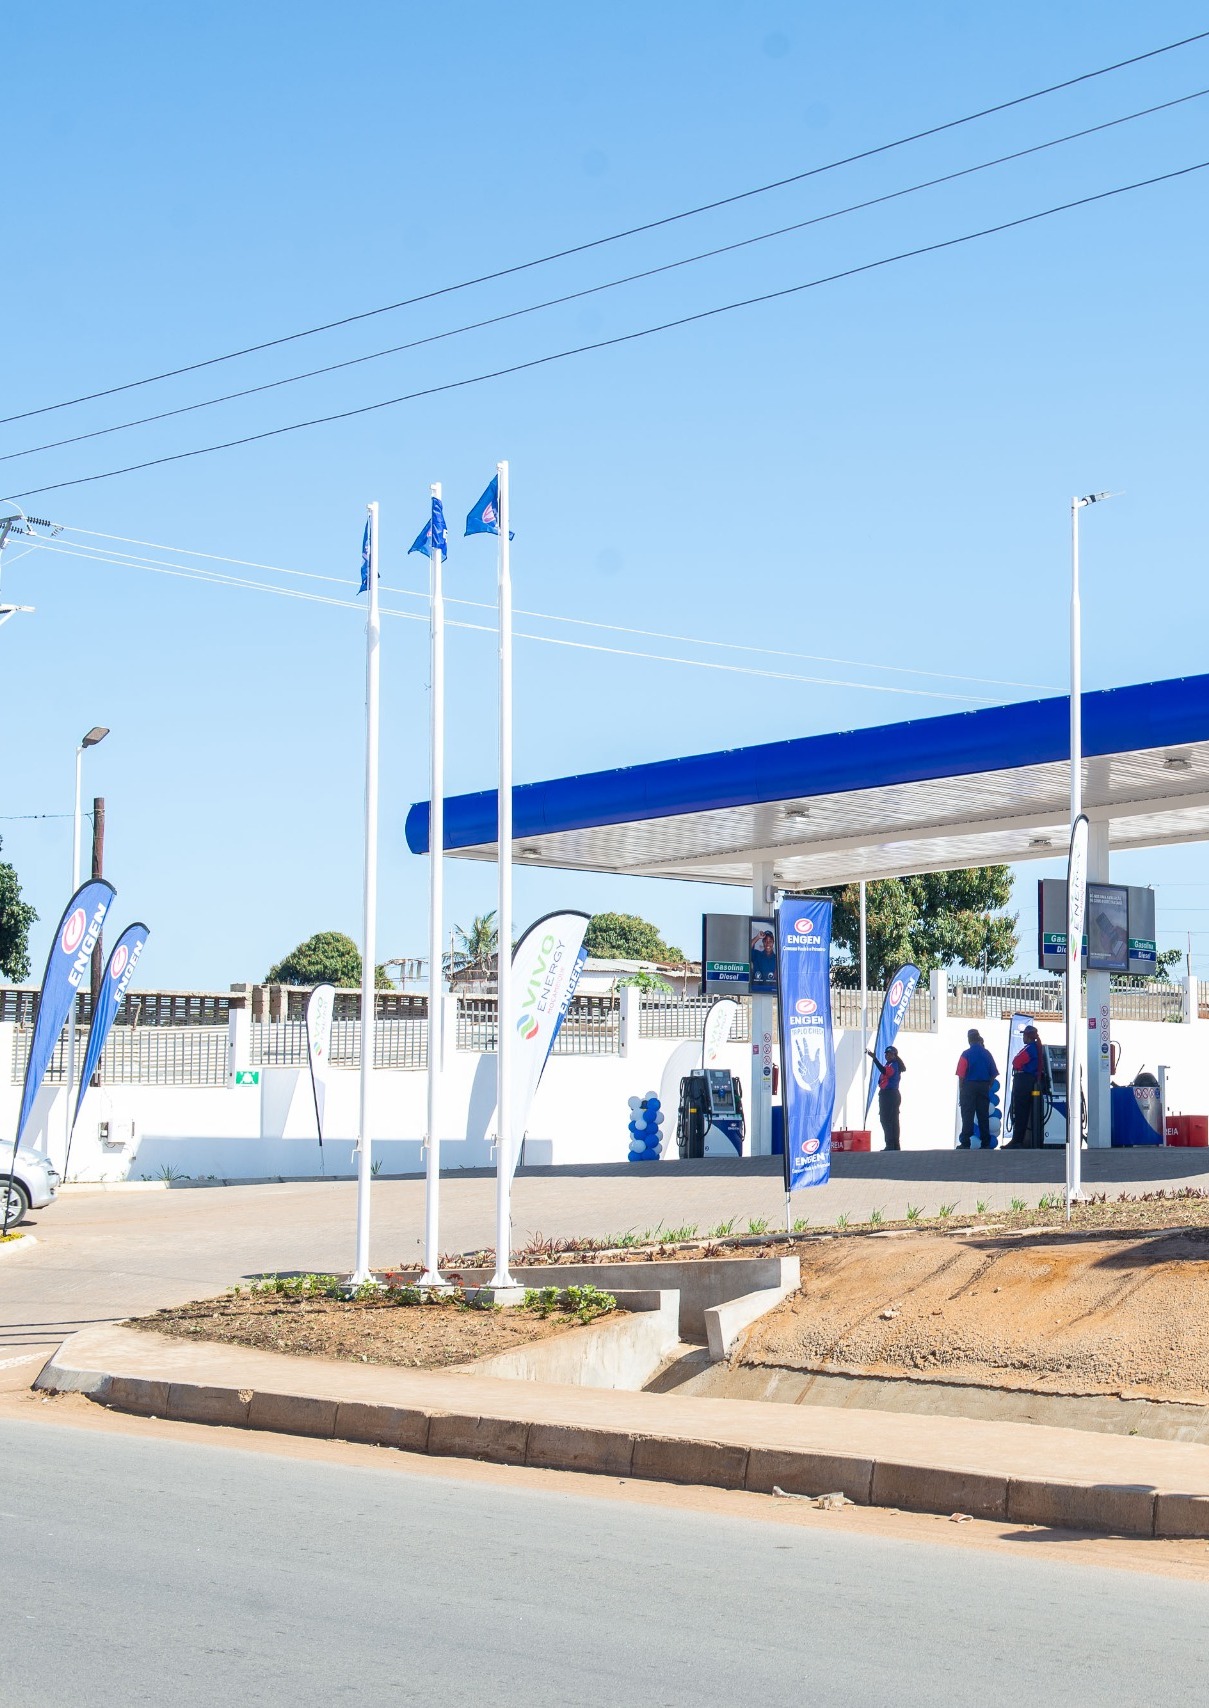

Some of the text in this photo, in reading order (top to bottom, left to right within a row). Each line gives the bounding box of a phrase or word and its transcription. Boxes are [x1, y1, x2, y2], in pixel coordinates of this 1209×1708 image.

[68, 902, 107, 988] ENGEN
[787, 934, 821, 945] ENGEN
[1134, 940, 1154, 950] Gasolina
[113, 940, 144, 1003] ENGEN
[522, 935, 555, 1008] VIVO
[537, 939, 566, 1012] ENERGY
[713, 963, 744, 972] Gasolina
[719, 973, 739, 981] Diesel
[894, 976, 916, 1026] ENGEN
[789, 1016, 824, 1025] ENGEN
